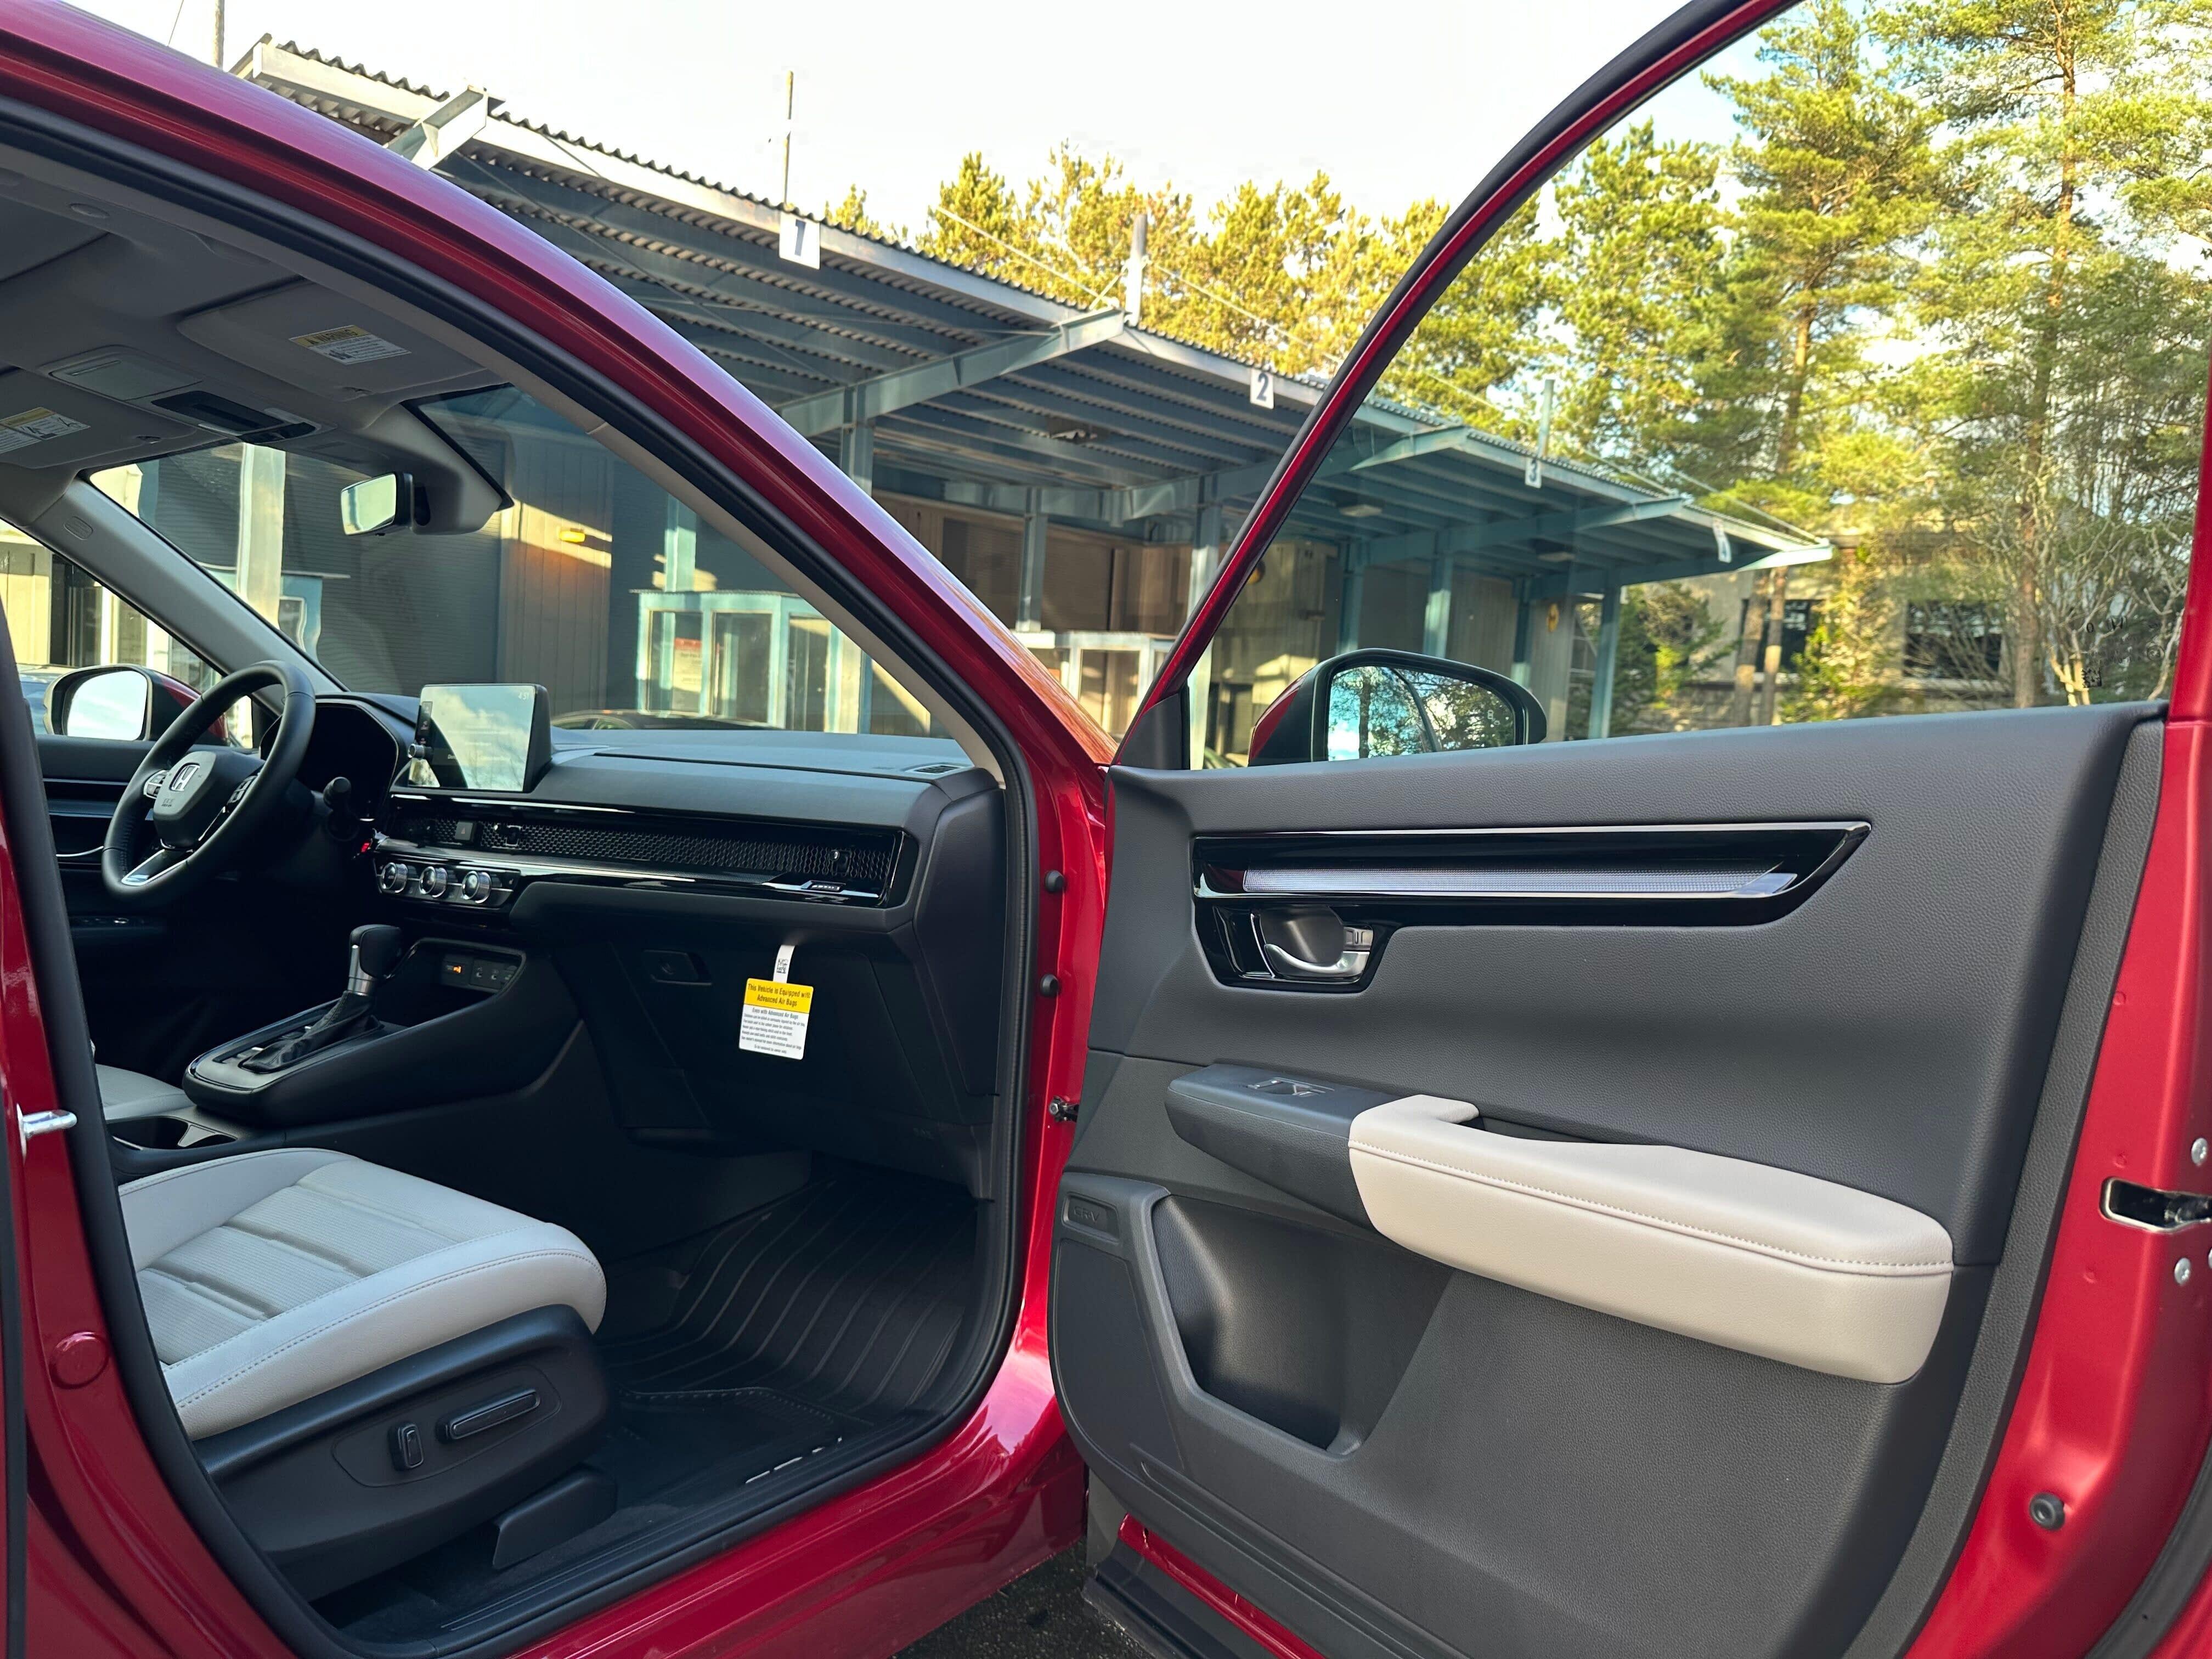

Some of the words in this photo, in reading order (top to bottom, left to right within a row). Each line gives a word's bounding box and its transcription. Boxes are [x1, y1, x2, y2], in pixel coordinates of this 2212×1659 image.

[794, 219, 806, 256] 1
[1256, 373, 1269, 401] 2
[1529, 459, 1538, 482] 3
[757, 994, 778, 1003] Advanced
[786, 998, 798, 1007] Bags
[758, 985, 773, 994] Vehicle
[779, 988, 800, 997] Equipped
[1074, 1206, 1100, 1222] CR-V
